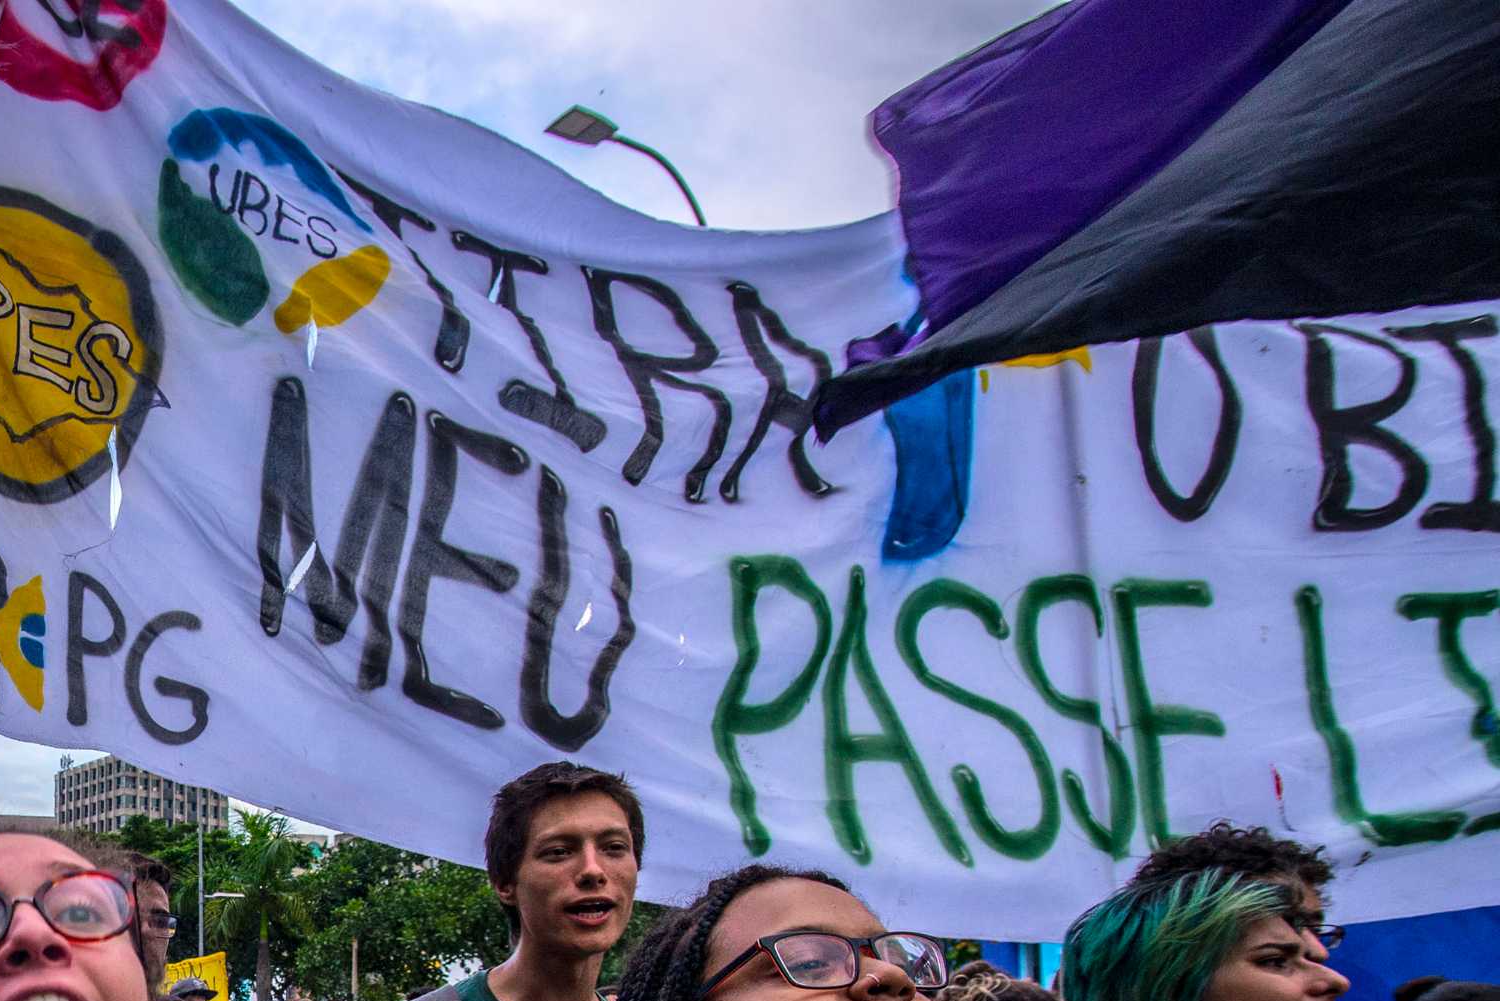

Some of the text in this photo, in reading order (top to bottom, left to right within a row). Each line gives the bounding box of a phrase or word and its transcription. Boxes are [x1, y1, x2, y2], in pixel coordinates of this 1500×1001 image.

[208, 162, 338, 259] UBES
[257, 375, 636, 751] MEU
[712, 553, 1226, 866] PASSE
